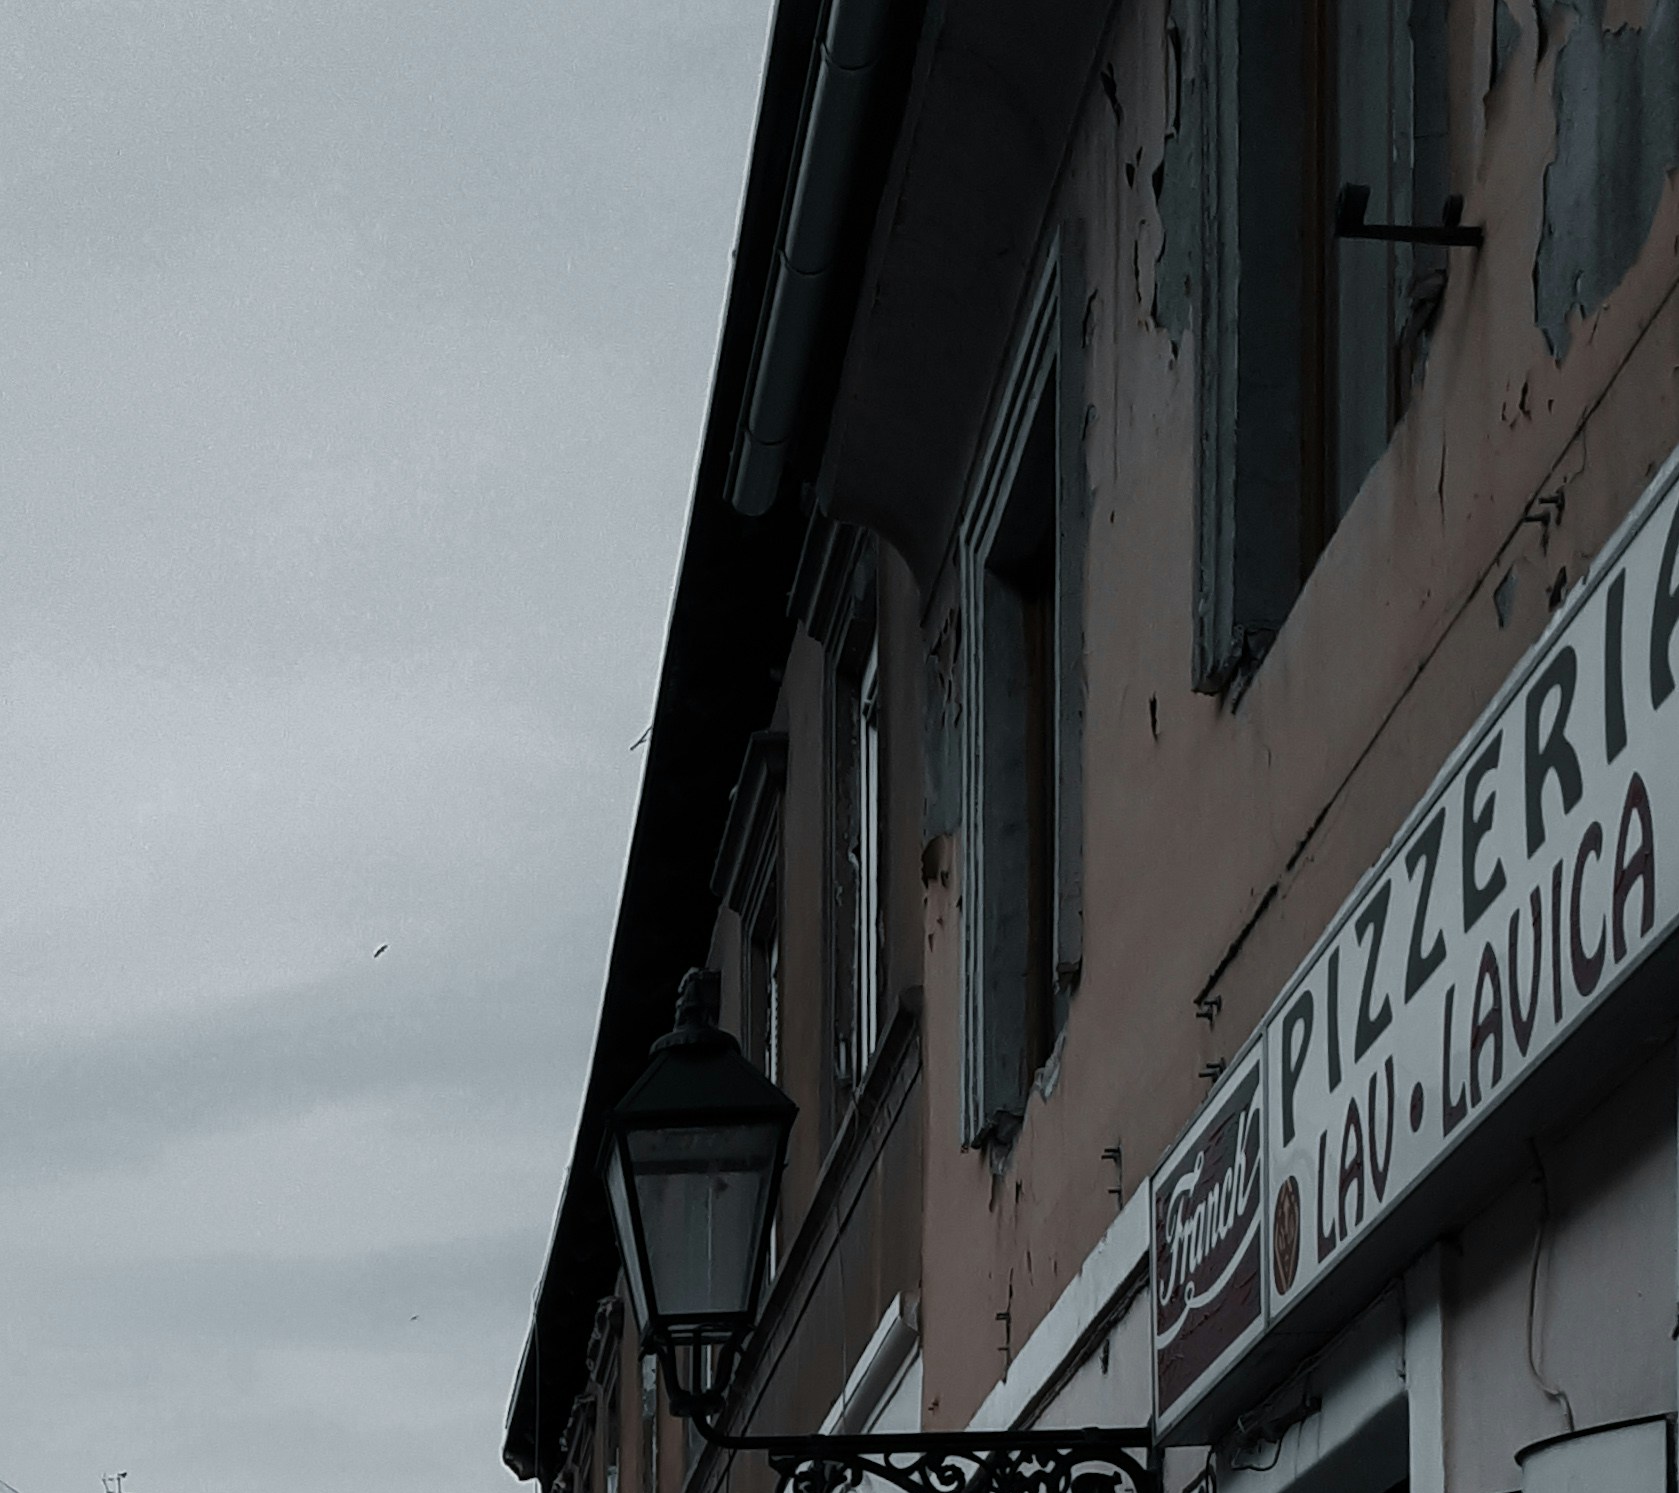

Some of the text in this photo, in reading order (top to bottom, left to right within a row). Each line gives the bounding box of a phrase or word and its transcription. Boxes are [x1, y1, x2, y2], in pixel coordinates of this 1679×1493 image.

[1317, 771, 1655, 1263] LAV LAVICA
[1158, 1086, 1260, 1306] Franck
